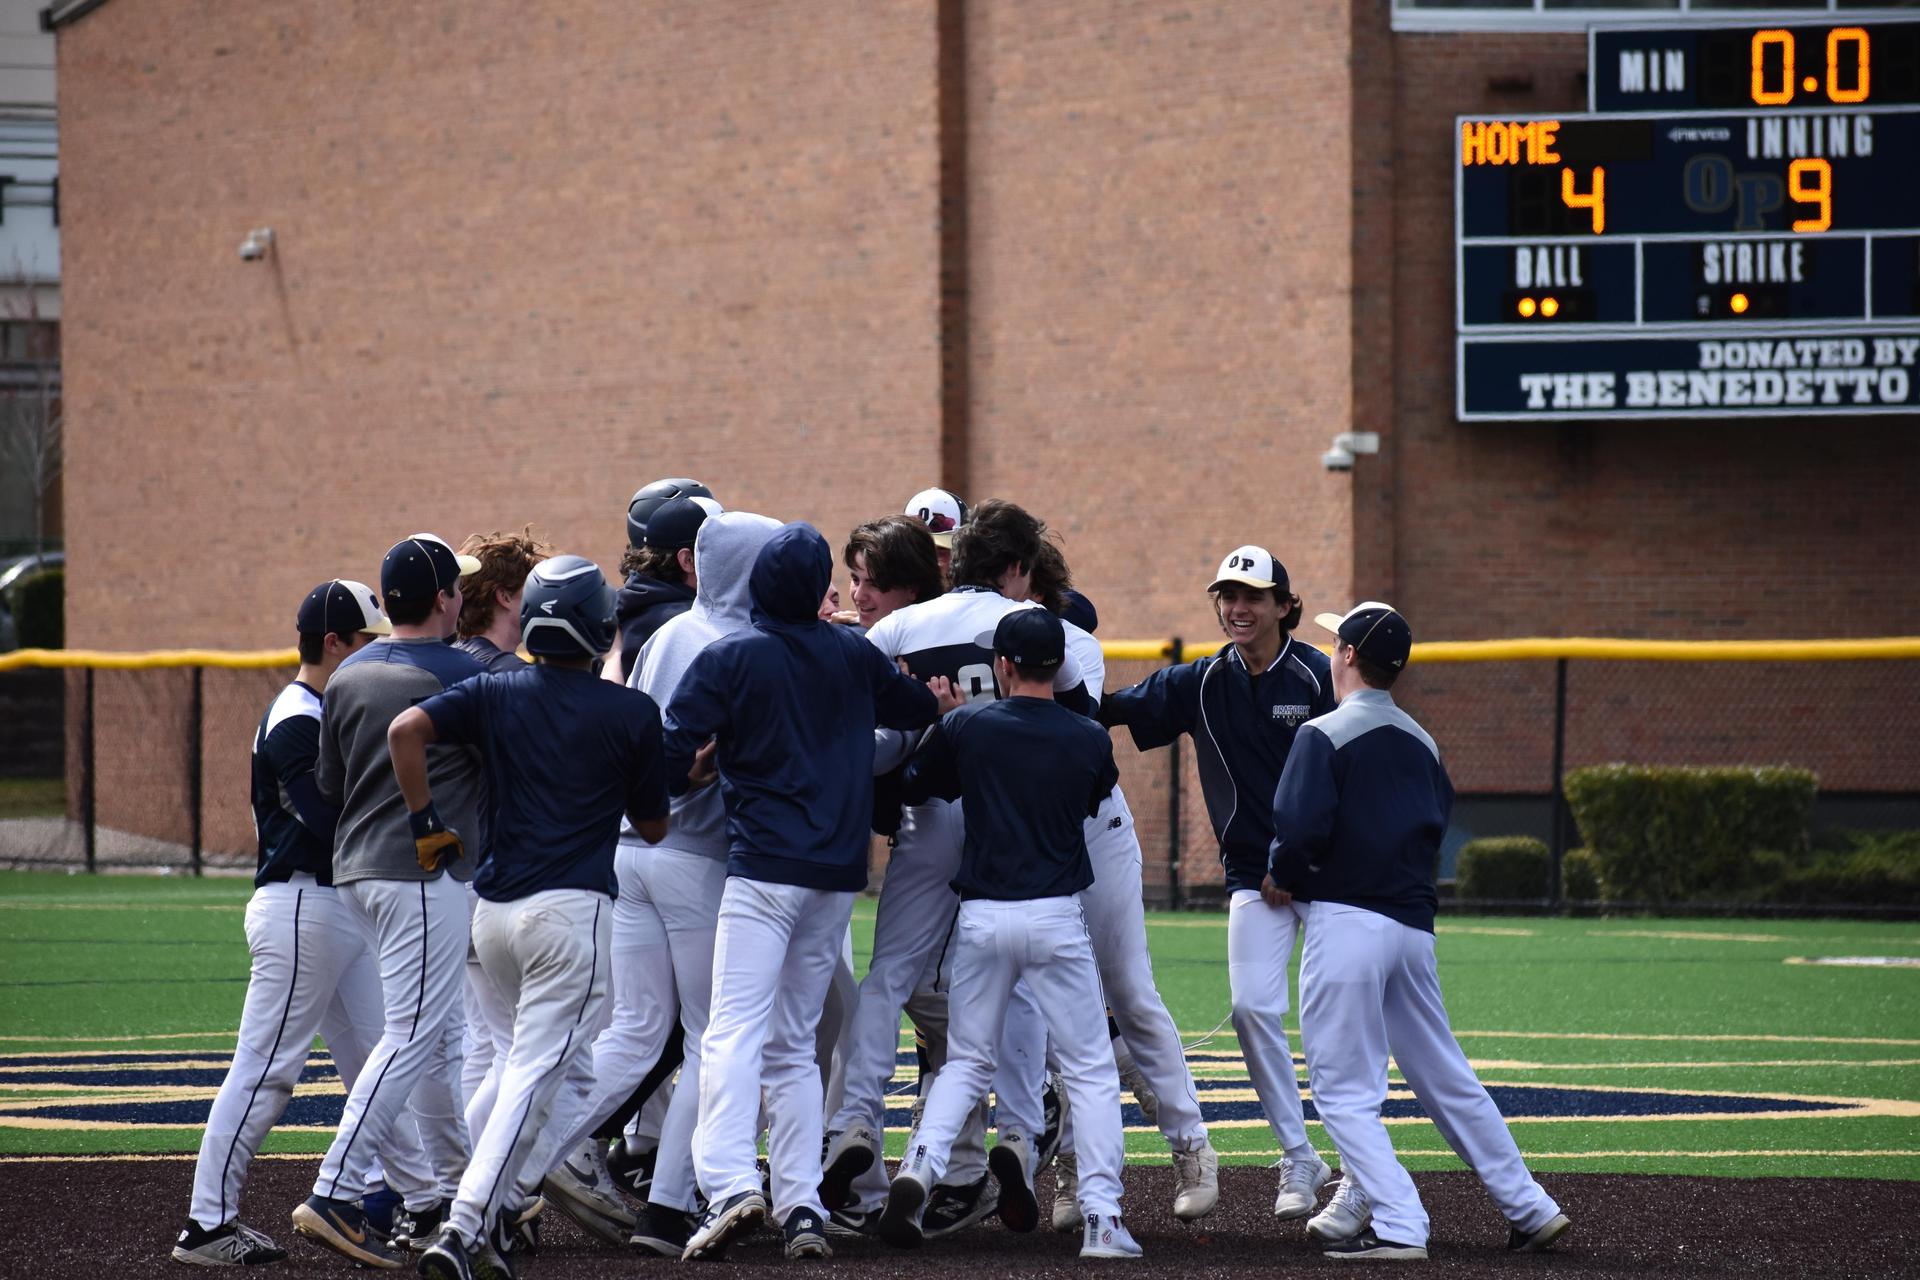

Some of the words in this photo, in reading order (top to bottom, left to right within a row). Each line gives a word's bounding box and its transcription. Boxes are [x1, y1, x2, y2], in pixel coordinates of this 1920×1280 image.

[1619, 50, 1684, 92] MIN
[1751, 27, 1870, 105] 0.0
[1462, 121, 1561, 166] HOME
[1746, 115, 1874, 159] INNING
[1562, 166, 1605, 234] 4
[1789, 158, 1831, 232] 9
[1516, 246, 1583, 288] BALL
[1703, 242, 1804, 283] STRIKE
[1700, 339, 1866, 369] DONATED
[1873, 338, 1920, 366] BY
[1520, 372, 1616, 409] THE
[1626, 368, 1909, 407] BENEDETTO
[1273, 705, 1310, 715] ORATORY
